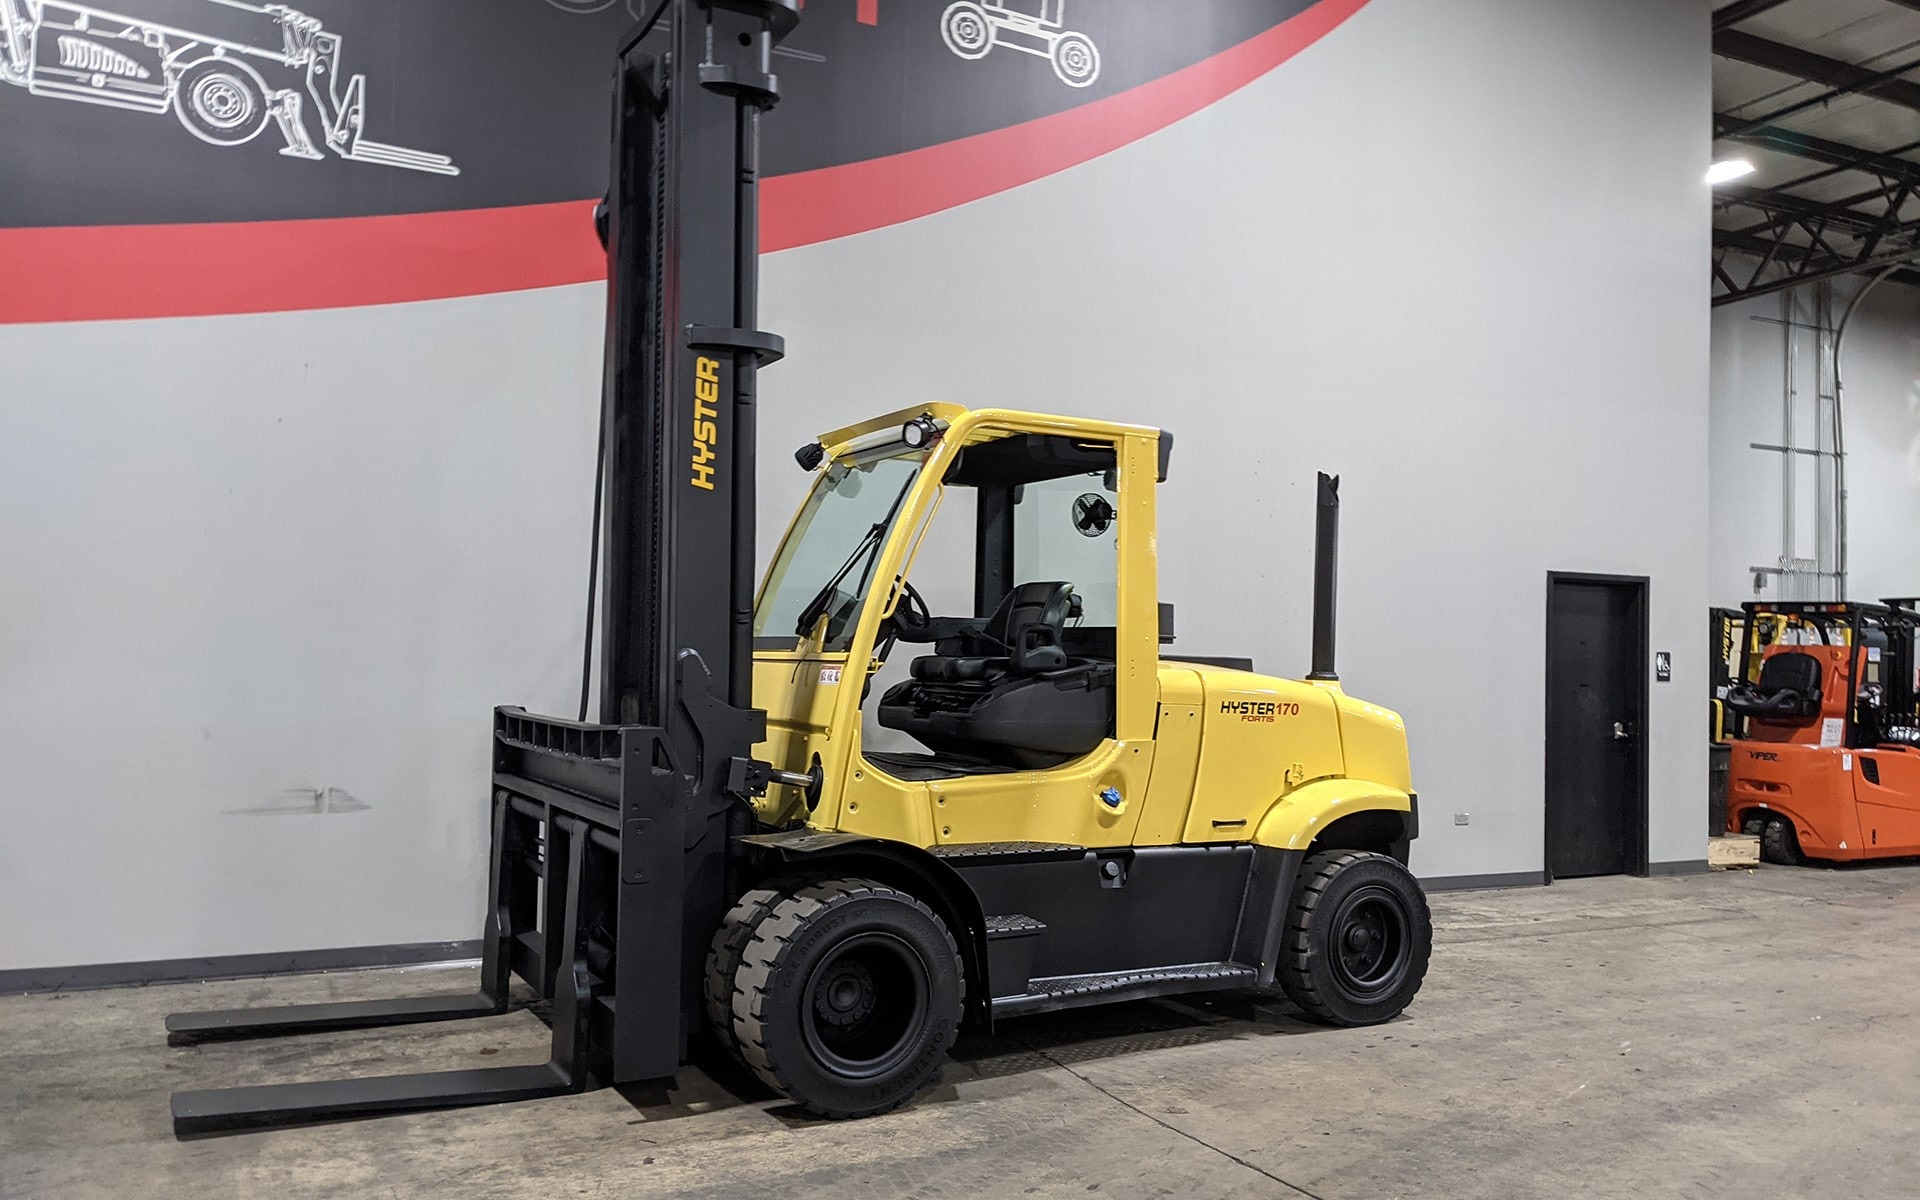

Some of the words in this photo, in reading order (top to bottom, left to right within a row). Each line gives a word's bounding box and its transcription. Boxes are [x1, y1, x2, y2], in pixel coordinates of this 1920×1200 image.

[690, 356, 720, 491] HYSTER
[1220, 701, 1275, 715] HYSTER
[1241, 715, 1275, 723] FORTIS
[1747, 750, 1778, 761] VIPER
